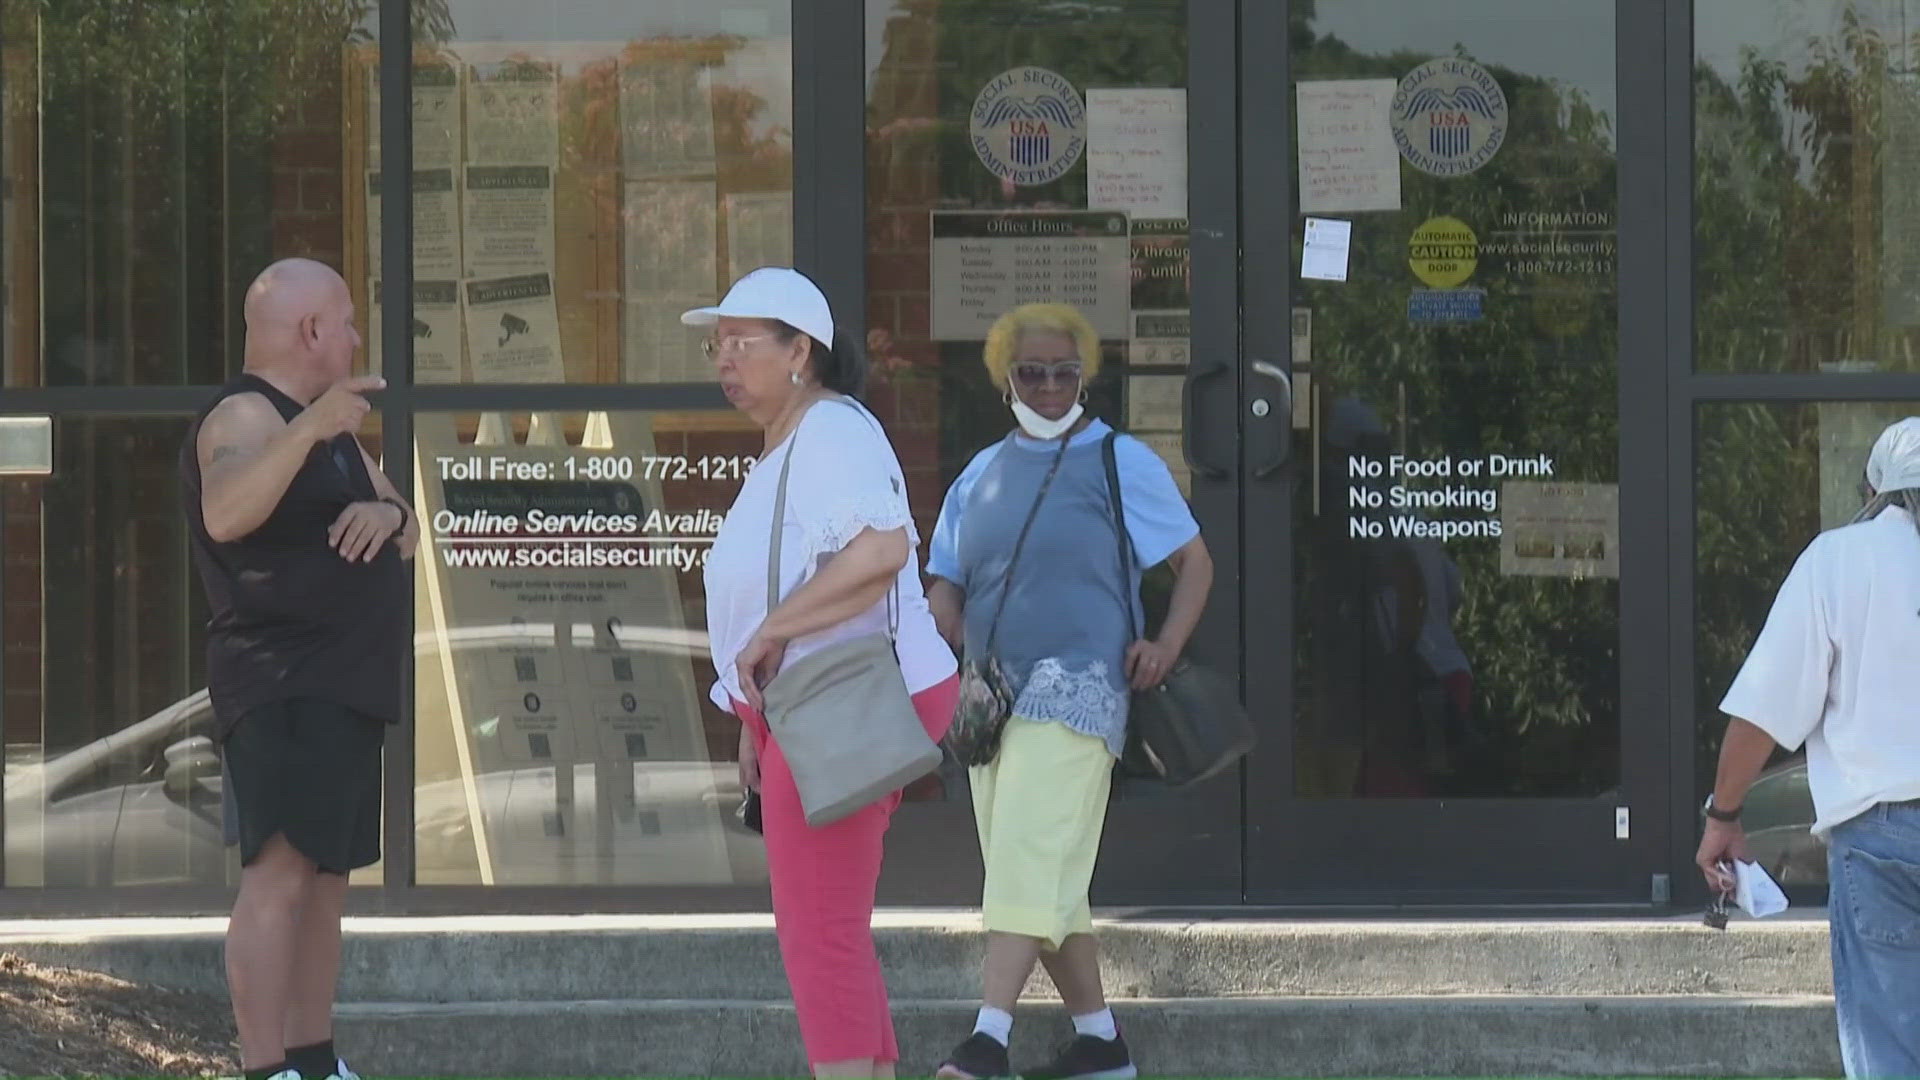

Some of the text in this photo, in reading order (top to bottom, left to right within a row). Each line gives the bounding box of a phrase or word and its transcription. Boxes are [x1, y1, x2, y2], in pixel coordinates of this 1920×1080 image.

[974, 70, 1083, 121] SOCIAL SECURITY
[1394, 67, 1436, 111] SOCIAL
[1443, 62, 1503, 111] SECURITY
[1010, 120, 1048, 135] USA
[1430, 112, 1468, 125] USA
[974, 135, 1081, 183] ADMINISTRATION
[1393, 127, 1502, 173] ADMINISTRATION
[987, 219, 1073, 233] Office Hours
[1503, 212, 1608, 225] INFORMATION
[1414, 231, 1472, 241] AUTOMATIC
[1411, 245, 1475, 258] CAUTION
[1428, 263, 1457, 272] DOOR
[1505, 260, 1611, 273] 1-800-772-1213
[436, 455, 757, 480] Toll Free: 1-800 772-1213
[1349, 454, 1554, 478] No Food or Drink
[1349, 485, 1497, 512] No Smoking
[433, 508, 724, 534] Online Services Availa
[1349, 516, 1502, 542] No Weapons
